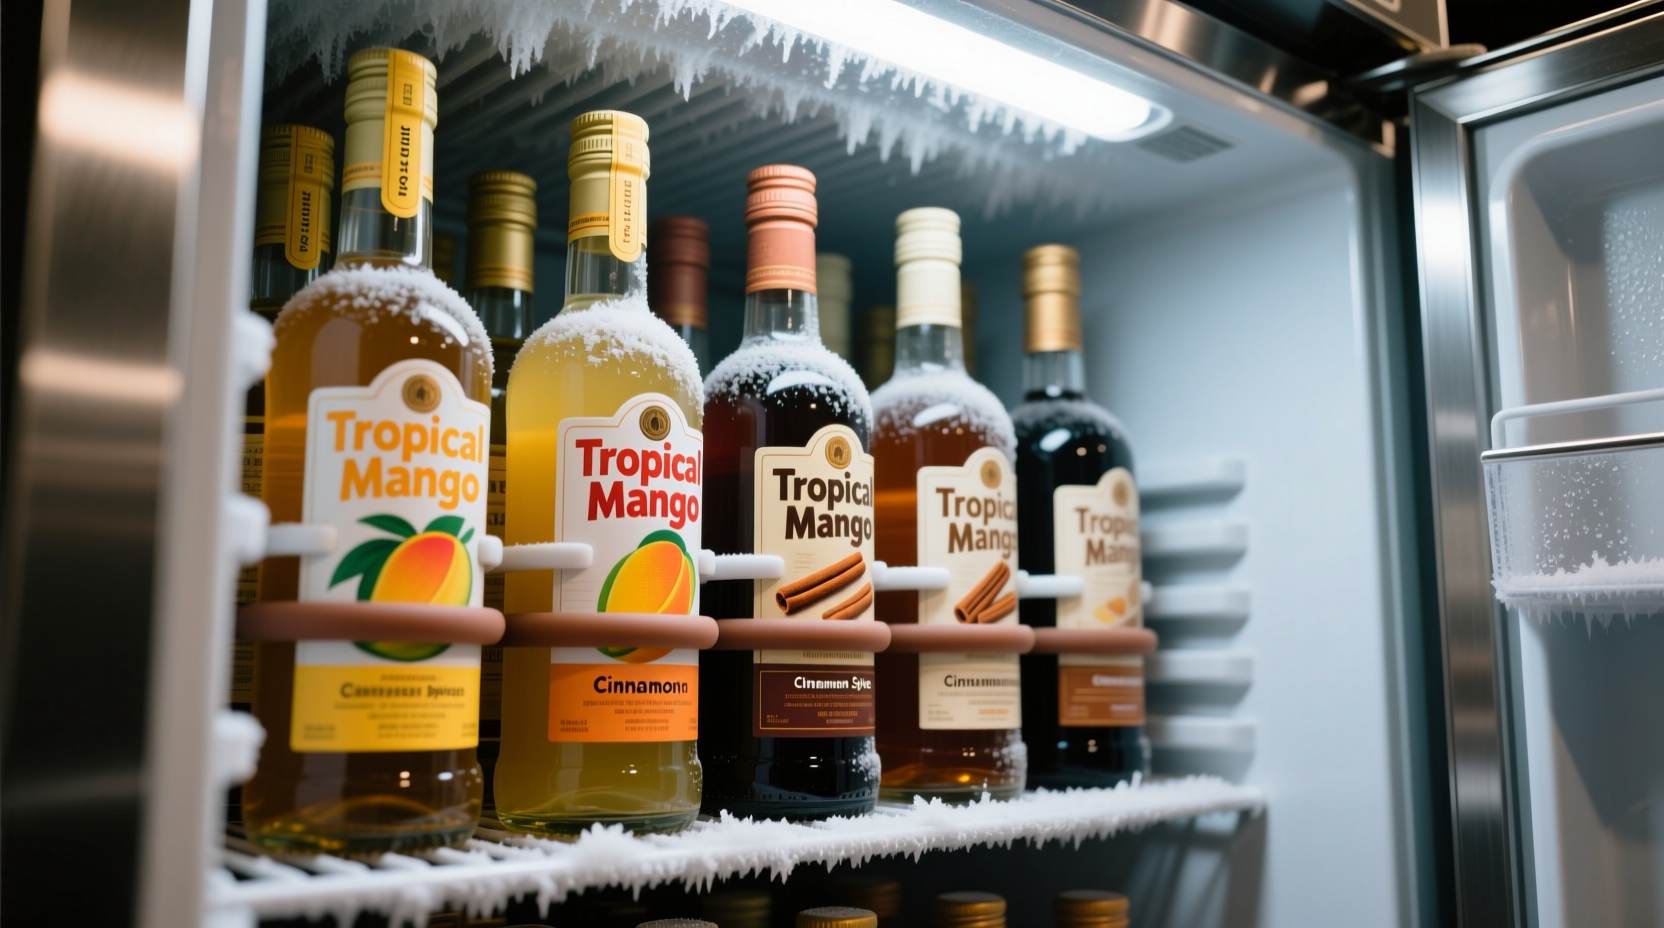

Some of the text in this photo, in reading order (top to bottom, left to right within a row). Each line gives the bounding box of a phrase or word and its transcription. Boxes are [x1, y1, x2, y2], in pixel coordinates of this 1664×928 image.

[326, 410, 484, 463] Tropical
[339, 456, 480, 511] Mango
[575, 438, 701, 484] Tropical
[587, 480, 699, 530] Mango
[773, 468, 874, 510] Tropical
[784, 505, 872, 548] Mango
